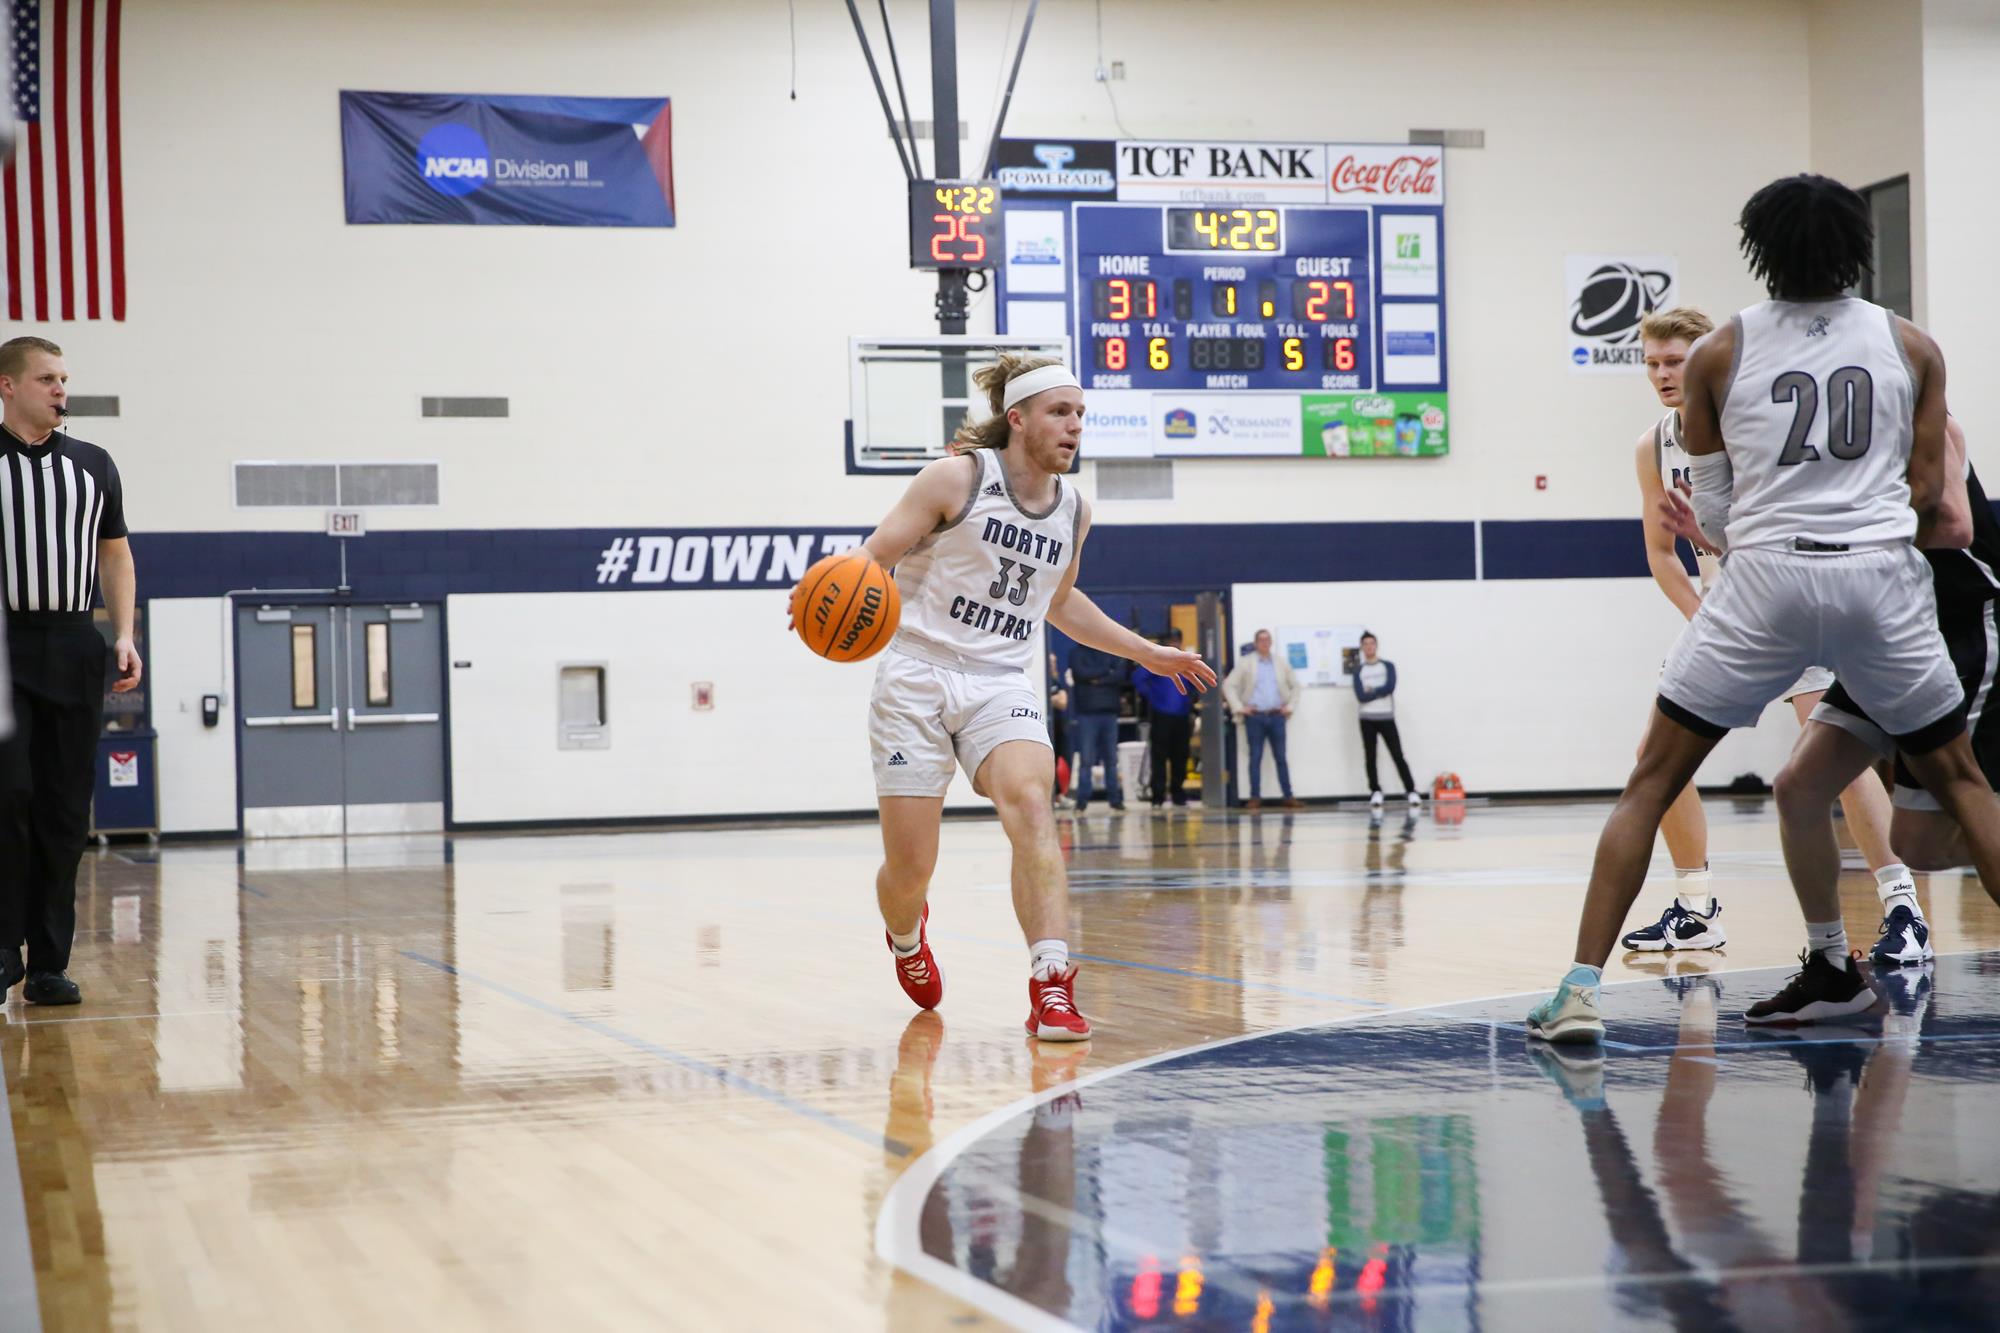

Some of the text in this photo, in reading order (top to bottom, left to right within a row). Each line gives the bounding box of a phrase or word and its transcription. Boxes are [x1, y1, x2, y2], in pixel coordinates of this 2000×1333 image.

[424, 157, 589, 179] NCAA Division III
[1122, 147, 1314, 178] TCF BANK
[1330, 155, 1438, 194] Coca-Cola
[1002, 172, 1107, 186] POWERADE
[936, 186, 994, 214] 4:22
[1180, 189, 1265, 201] tcfbank.com
[931, 214, 986, 261] 25
[1194, 209, 1277, 250] 4:22
[1099, 255, 1150, 276] HOME
[1203, 267, 1246, 282] PERIOD
[1296, 257, 1352, 278] GUEST
[1108, 280, 1156, 320] 31
[1226, 287, 1235, 314] 1
[1306, 281, 1354, 321] 27
[1092, 323, 1130, 337] FOULS
[1186, 323, 1267, 338] PLAYER FOUL
[1321, 324, 1359, 338] FOULS
[1106, 337, 1127, 370] 8
[1149, 337, 1170, 370] 6
[1283, 338, 1304, 371] 5
[1334, 338, 1355, 371] 6
[1093, 375, 1132, 389] SCORE
[1206, 375, 1248, 389] MATCH
[1322, 375, 1360, 389] SCORE
[1085, 413, 1148, 428] Homes
[1771, 366, 1873, 466] 20
[332, 513, 360, 531] EXIT
[982, 517, 1063, 566] NORTH
[989, 556, 1037, 607] 33
[837, 586, 882, 651] Wilson
